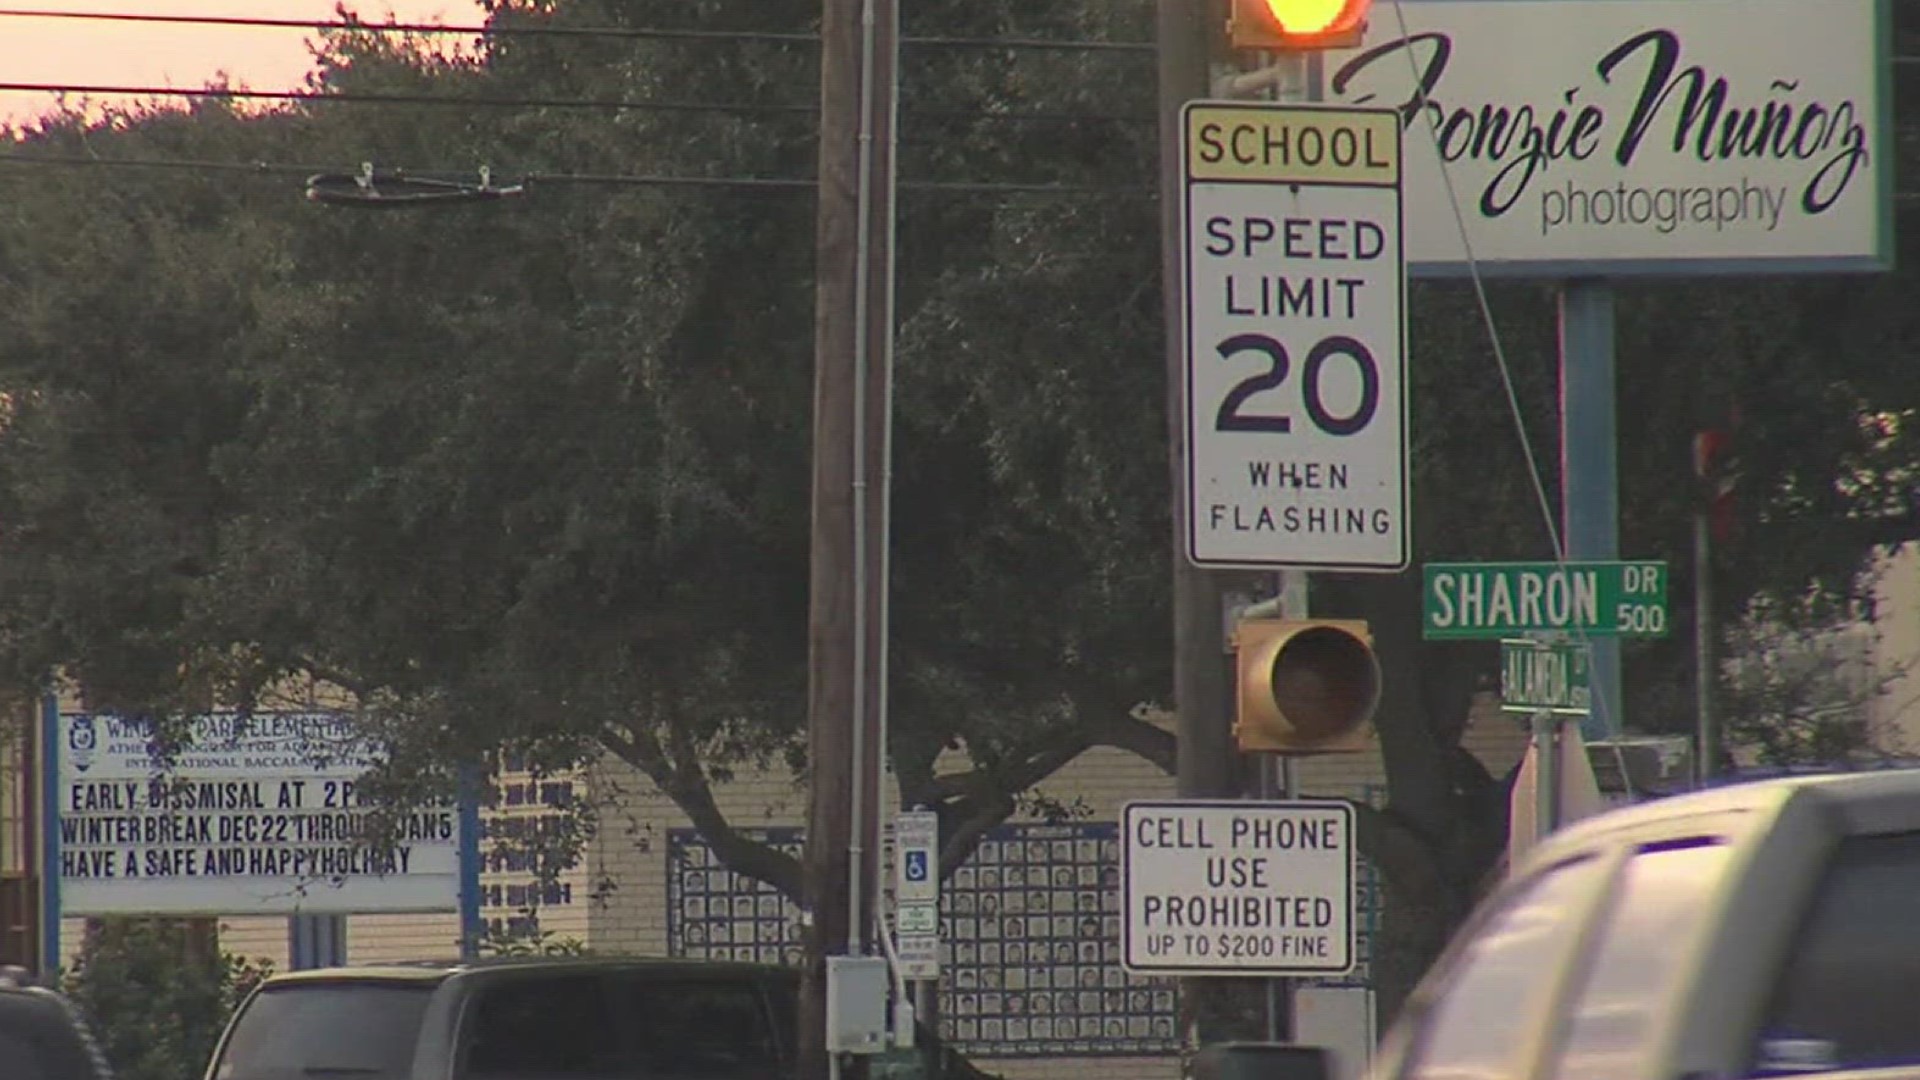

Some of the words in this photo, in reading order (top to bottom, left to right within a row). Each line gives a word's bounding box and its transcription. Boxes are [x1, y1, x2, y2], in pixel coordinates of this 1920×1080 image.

[1597, 29, 1869, 215] Muñoz
[1200, 124, 1390, 168] SCHOOL
[1541, 177, 1787, 237] photography
[1205, 217, 1385, 260] SPEED
[1226, 275, 1365, 318] LIMIT
[1215, 333, 1380, 437] 20
[1249, 461, 1349, 490] WHEN
[1211, 504, 1390, 535] FLASHING
[1432, 571, 1598, 627] SHARON
[1623, 566, 1658, 593] DR
[1616, 604, 1665, 633] 500
[249, 715, 368, 738] ELEMENTAR
[248, 740, 277, 753] FOR
[125, 757, 238, 769] INTATIONAL
[72, 783, 137, 810] EARLY
[149, 781, 264, 810] DISSMISAL
[277, 781, 304, 808] AT
[61, 816, 141, 844] WINTER
[219, 815, 257, 842] DEC
[291, 814, 389, 841] THROU
[1137, 817, 1214, 848] CELL
[1231, 818, 1338, 849] PHONE
[63, 850, 115, 877] HAVE
[126, 850, 138, 876] A
[145, 849, 197, 876] SAFE
[204, 849, 245, 875] AND
[249, 849, 319, 875] HAPPY
[1207, 857, 1268, 888] USE
[1144, 896, 1332, 928] PROHIBITED
[1147, 934, 1175, 956] UP
[1185, 934, 1210, 956] TO
[1217, 933, 1274, 959] $200
[1281, 935, 1329, 957] FINE
